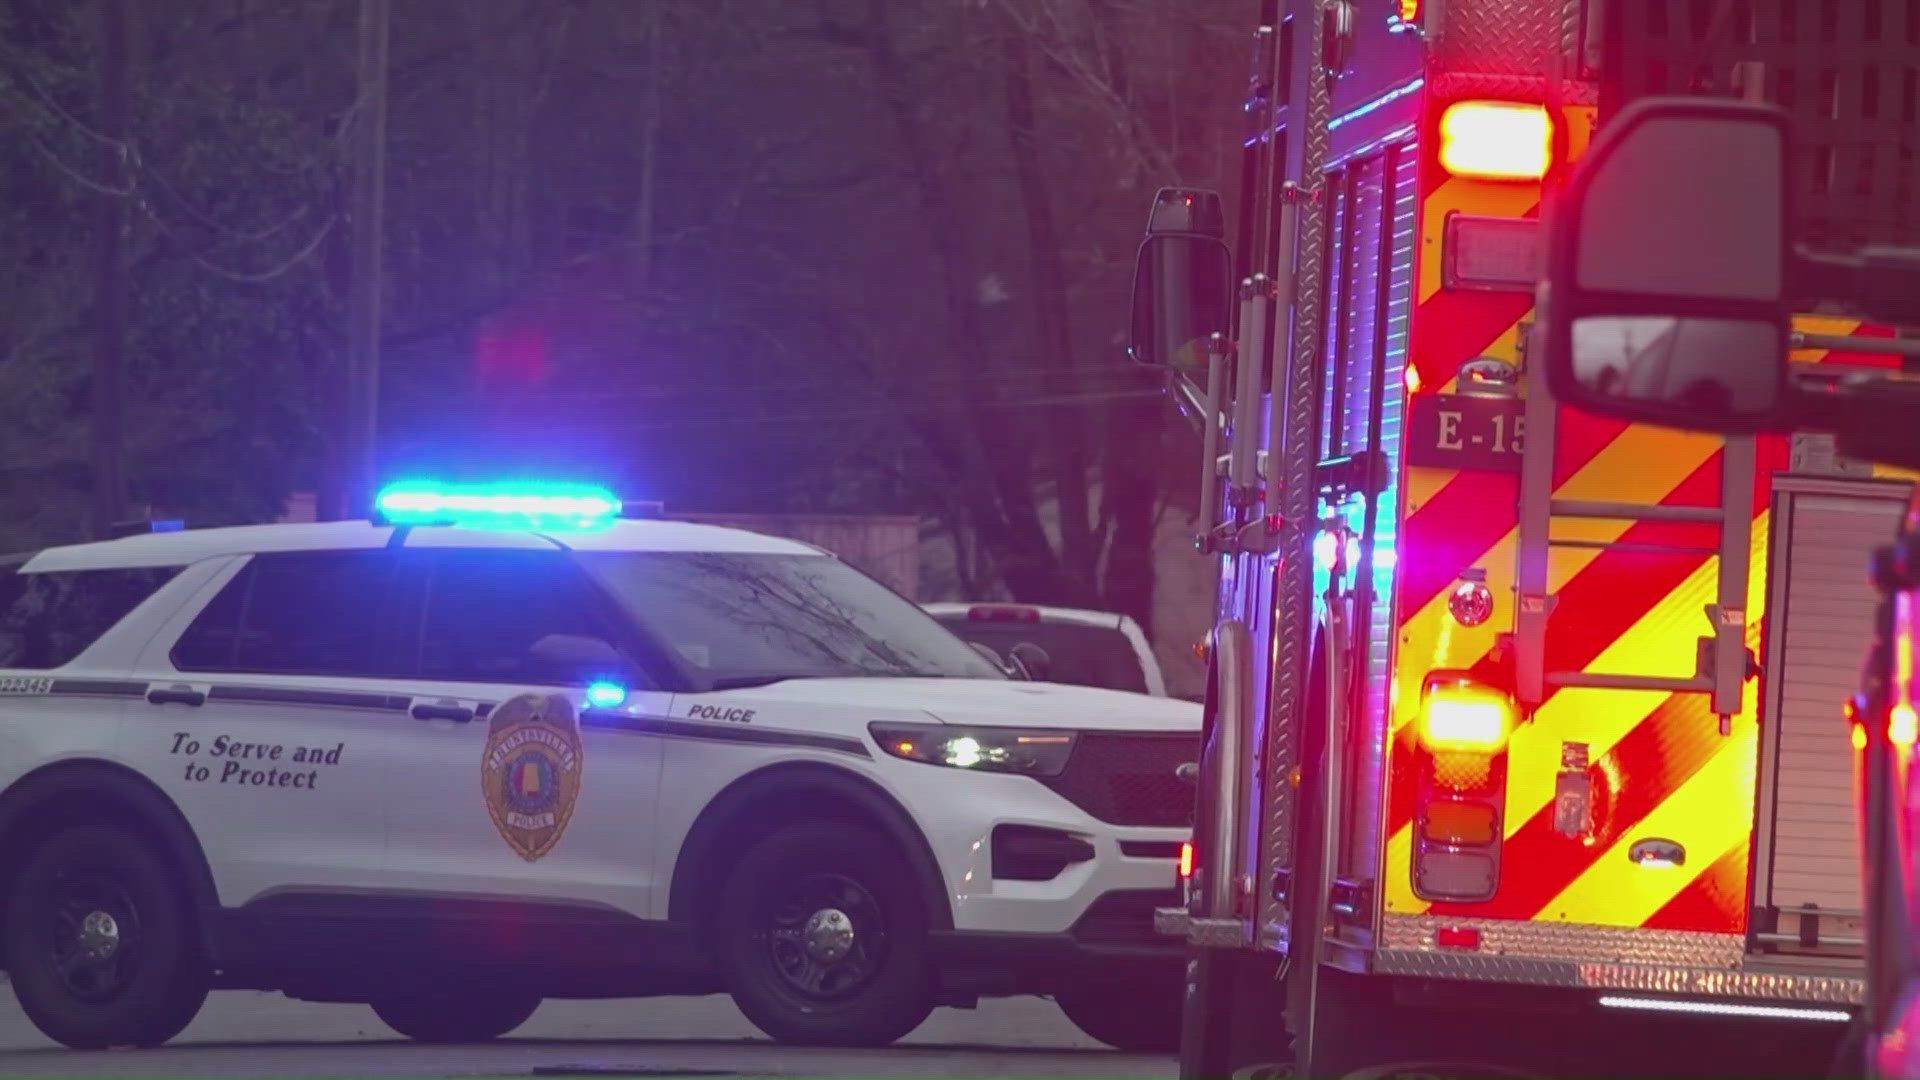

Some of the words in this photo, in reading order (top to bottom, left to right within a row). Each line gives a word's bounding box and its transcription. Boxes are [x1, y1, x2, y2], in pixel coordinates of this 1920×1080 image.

[1437, 411, 1525, 454] E-15
[0, 677, 49, 693] 22345
[687, 704, 756, 723] POLICE
[170, 732, 200, 755] To
[210, 735, 283, 760] Serve
[293, 742, 344, 765] and
[184, 762, 210, 782] to
[220, 760, 318, 789] Protect
